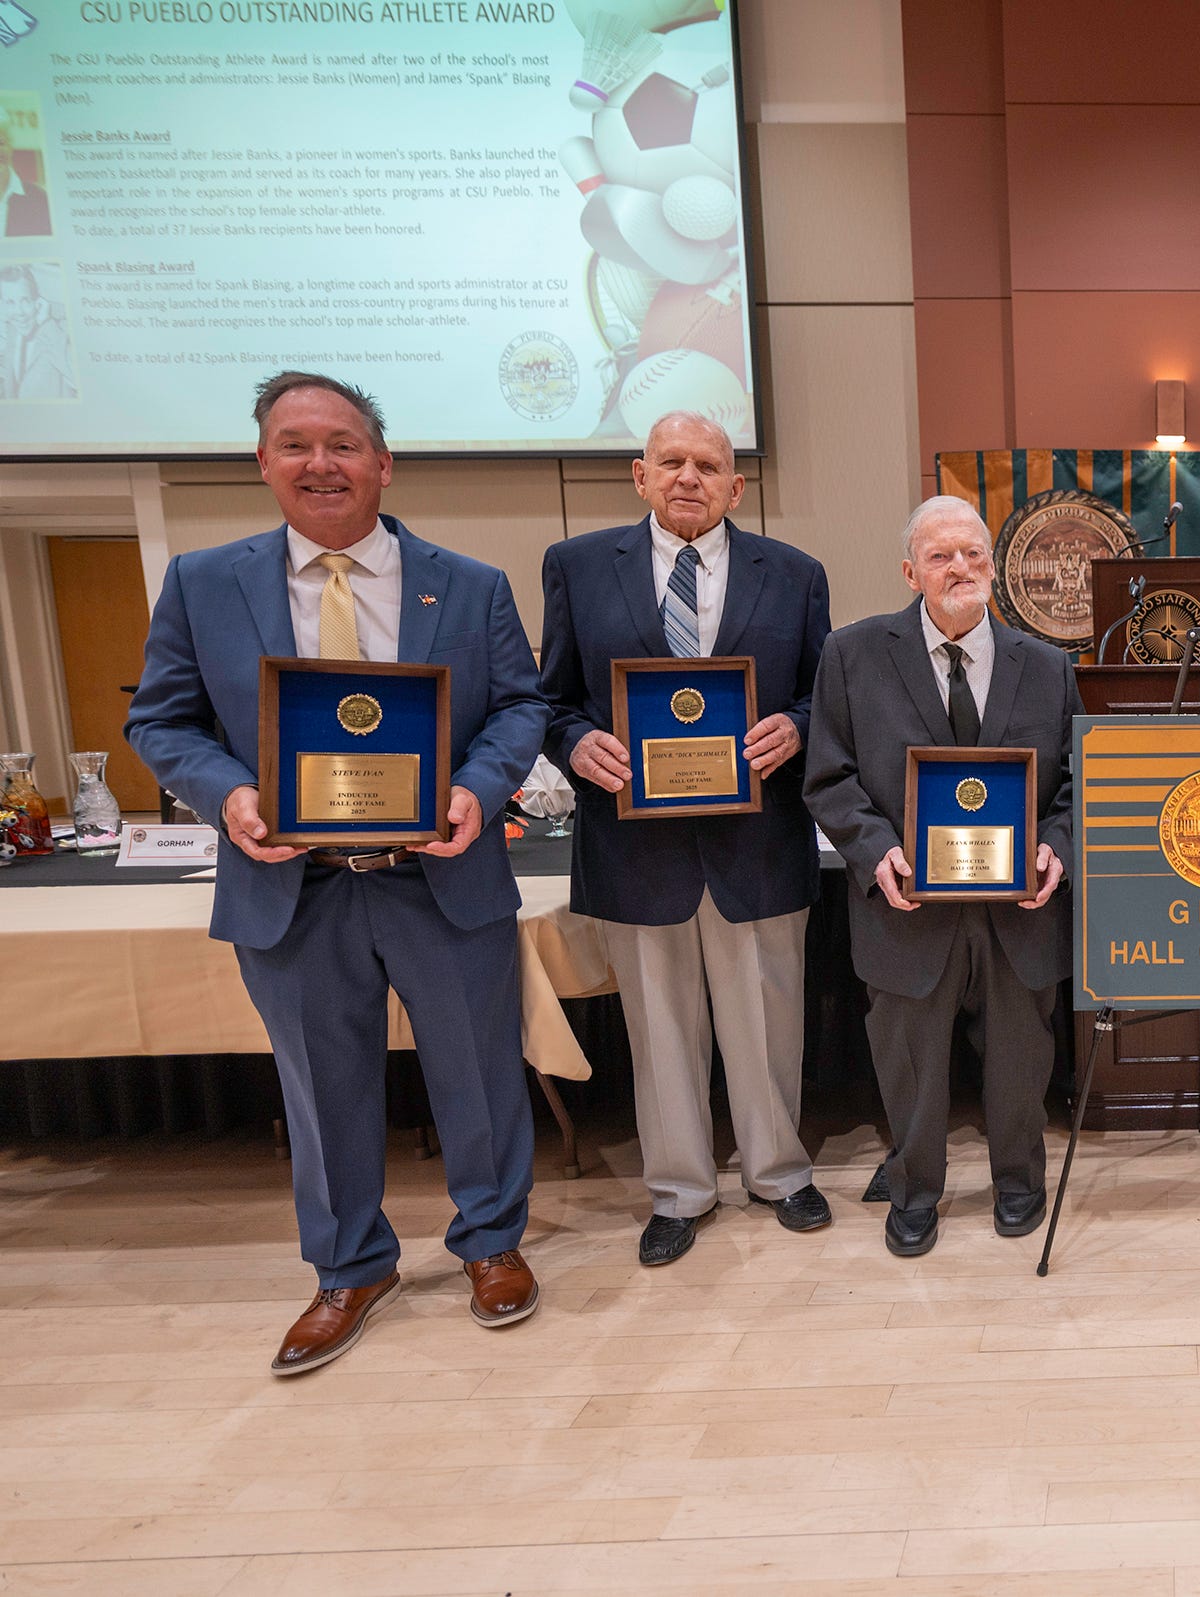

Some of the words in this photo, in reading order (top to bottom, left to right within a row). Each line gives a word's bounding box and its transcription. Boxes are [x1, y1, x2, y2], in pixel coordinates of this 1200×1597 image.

[79, 2, 122, 23] CSU
[128, 2, 213, 23] PUEBLO
[218, 2, 373, 23] OUTSTANDING
[380, 2, 468, 23] ATHLETE
[475, 2, 554, 23] AWARD
[50, 54, 71, 65] The
[76, 54, 100, 65] CSU
[104, 54, 145, 65] Pueblo
[149, 54, 220, 68] Outstanding
[224, 54, 265, 65] Athlete
[270, 54, 308, 65] Award
[312, 54, 321, 65] is
[326, 54, 366, 65] named
[370, 54, 396, 65] after
[402, 54, 424, 65] two
[429, 54, 442, 65] of
[446, 54, 466, 65] the
[521, 54, 549, 65] most
[52, 73, 112, 87] prominent
[115, 73, 161, 84] coaches
[164, 73, 186, 84] and
[276, 73, 308, 84] Jessie
[312, 73, 345, 84] Banks
[403, 73, 425, 84] and
[428, 73, 462, 84] James
[512, 72, 550, 87] Blasing
[60, 130, 92, 142] Jessie
[95, 130, 130, 142] Banks
[132, 130, 171, 142] Award
[1156, 594, 1185, 606] STATE
[1110, 940, 1185, 964] HALL
